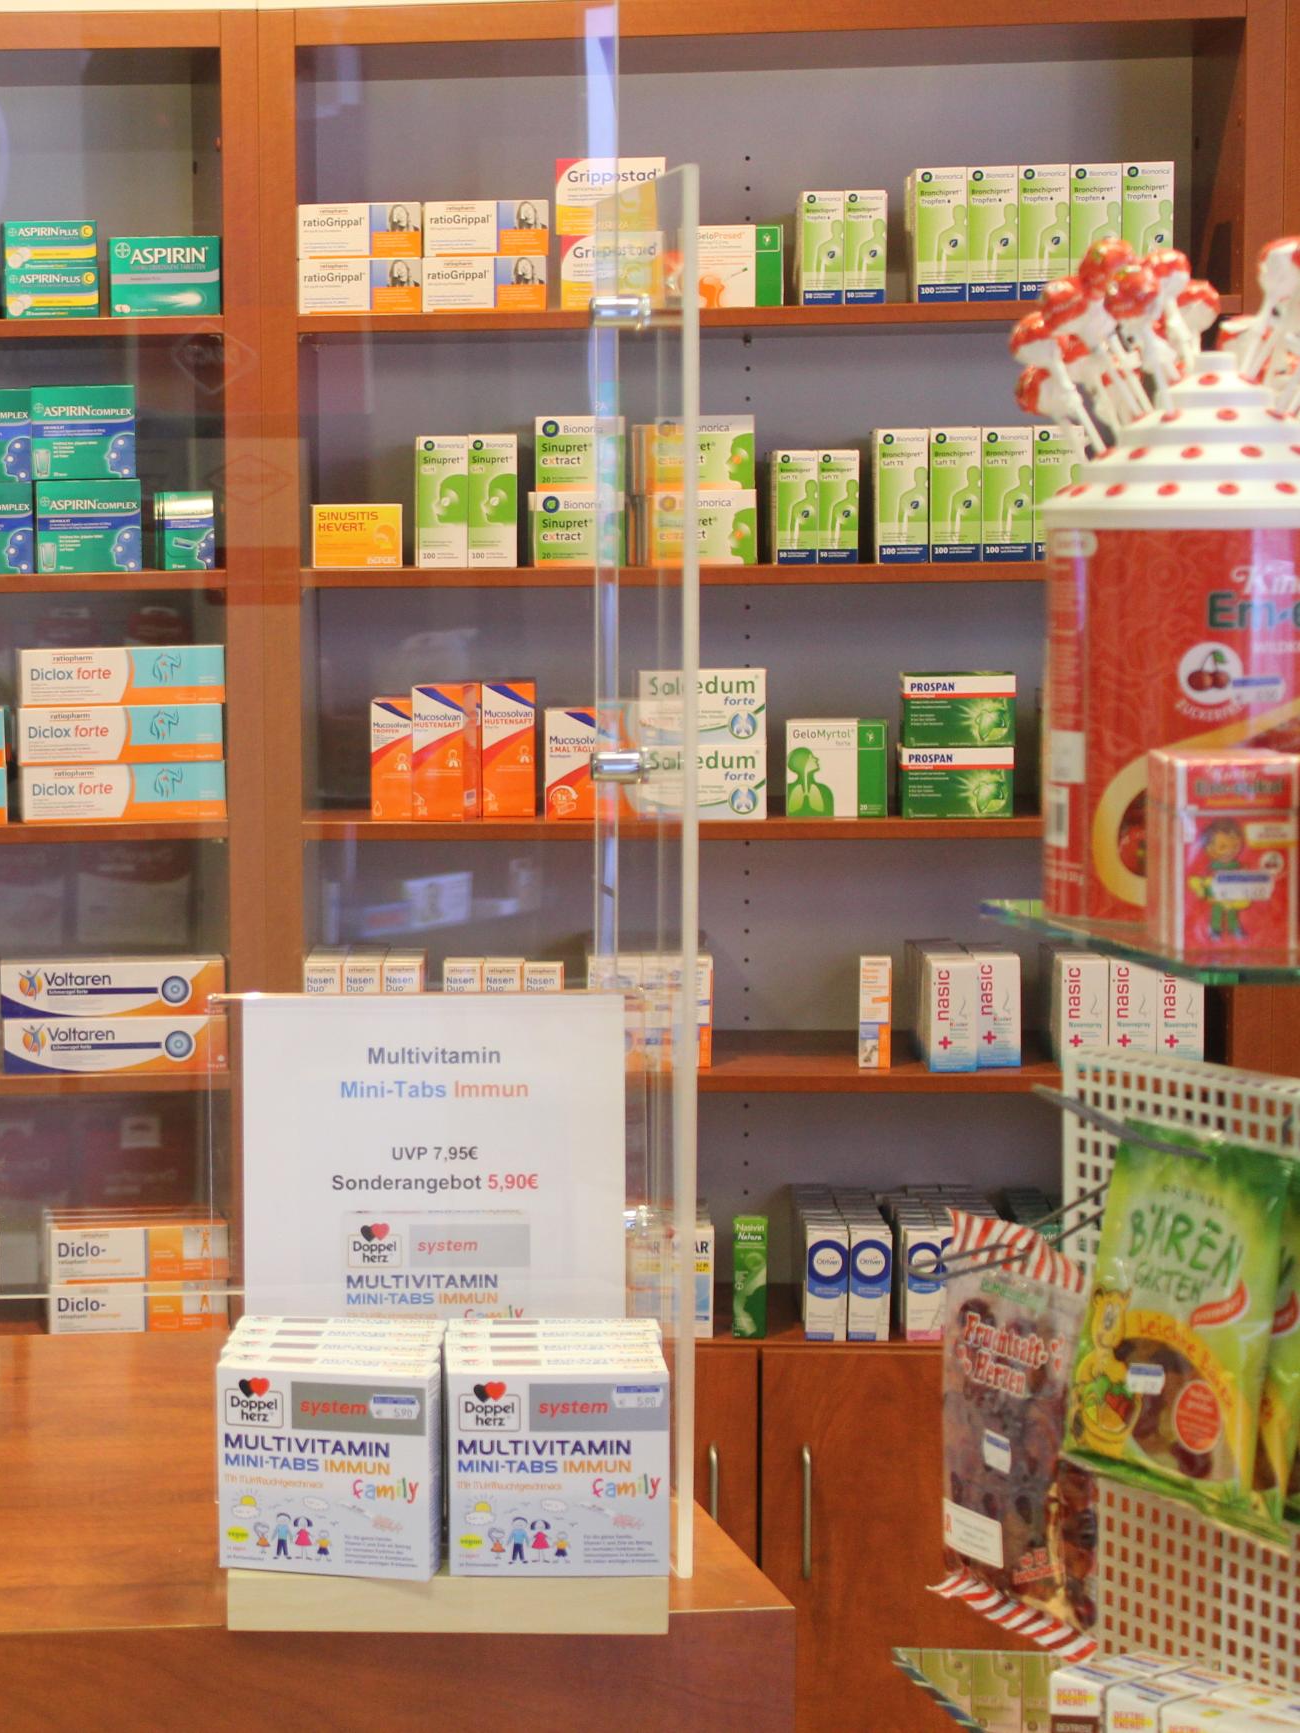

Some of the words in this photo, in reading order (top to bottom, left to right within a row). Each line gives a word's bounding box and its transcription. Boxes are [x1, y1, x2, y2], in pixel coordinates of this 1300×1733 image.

[303, 217, 362, 228] ratioGrippal
[430, 214, 488, 226] ratioGrippal
[18, 227, 58, 236] ASPIRIN
[130, 248, 206, 265] ASPIRIN
[19, 274, 60, 284] ASPIRIN
[61, 276, 80, 284] PLUS
[303, 272, 363, 283] ratioGrippal
[427, 270, 487, 282] ratioGrippal
[44, 406, 90, 417] ASPIRIN
[91, 408, 132, 416] COMPLEX
[542, 443, 587, 453] Sinupret
[423, 456, 460, 465] Sinupret
[472, 455, 508, 465] Sinupret
[542, 456, 581, 465] extract
[49, 500, 96, 511] ASPIRIN
[97, 502, 138, 510] COMPLEX
[318, 511, 378, 522] SINUSITIS
[542, 519, 588, 529] Sinupret
[542, 531, 581, 541] extract
[423, 552, 436, 560] 100
[472, 552, 485, 560] 100
[30, 668, 74, 681] Diclox
[77, 667, 112, 681] forte
[911, 683, 955, 692] PROSPAN
[724, 696, 755, 706] forte
[414, 713, 461, 722] Mucosolvan
[484, 710, 532, 719] Mucosolvan
[28, 726, 71, 739] Diclox
[74, 725, 110, 739] forte
[793, 729, 851, 739] GeloMyrtol
[909, 754, 953, 763] PROSPAN
[724, 771, 755, 781] forte
[32, 783, 75, 797] Diclox
[79, 782, 113, 796] forte
[44, 971, 112, 986] Voltaren
[307, 976, 334, 985] Nasen
[347, 976, 374, 985] Nasen
[386, 976, 413, 985] Nasen
[447, 976, 474, 985] Nasen
[486, 976, 514, 985] Nasen
[527, 977, 554, 985] Nasen
[934, 969, 950, 1022] nasic
[977, 964, 993, 1016] nasic
[1064, 967, 1081, 1019] nasic
[1112, 967, 1130, 1019] nasic
[48, 1027, 115, 1042] Voltaren
[367, 1047, 501, 1065] Multivitamin
[340, 1080, 446, 1099] Mini-Tabs
[455, 1080, 529, 1098] Immun
[392, 1147, 428, 1161] UVP
[433, 1146, 478, 1163] 7,95€
[332, 1174, 481, 1195] Sonderangebot
[488, 1173, 539, 1192] 5,90€
[58, 1242, 107, 1259] Diclo-
[353, 1240, 397, 1257] Doppel
[417, 1238, 479, 1256] system
[362, 1251, 389, 1264] herz
[346, 1274, 498, 1289] MULTIVITAMIN
[346, 1293, 435, 1305] MINI-TABS
[439, 1292, 497, 1304] IMMUN
[57, 1297, 106, 1313] Diclo-
[231, 1396, 278, 1411] Doppel
[300, 1399, 367, 1416] system
[465, 1401, 514, 1415] Doppel
[539, 1401, 609, 1417] system
[241, 1411, 269, 1423] herz
[475, 1415, 505, 1427] herz
[224, 1432, 390, 1458] MULTIVITAMIN
[458, 1440, 631, 1456] MULTIVITAMIN
[225, 1453, 319, 1472] MINI-TABS
[324, 1460, 390, 1475] IMMUN
[458, 1460, 558, 1473] MINI-TABS
[563, 1460, 632, 1473] IMMUN
[352, 1478, 419, 1504] family
[592, 1473, 661, 1499] family
